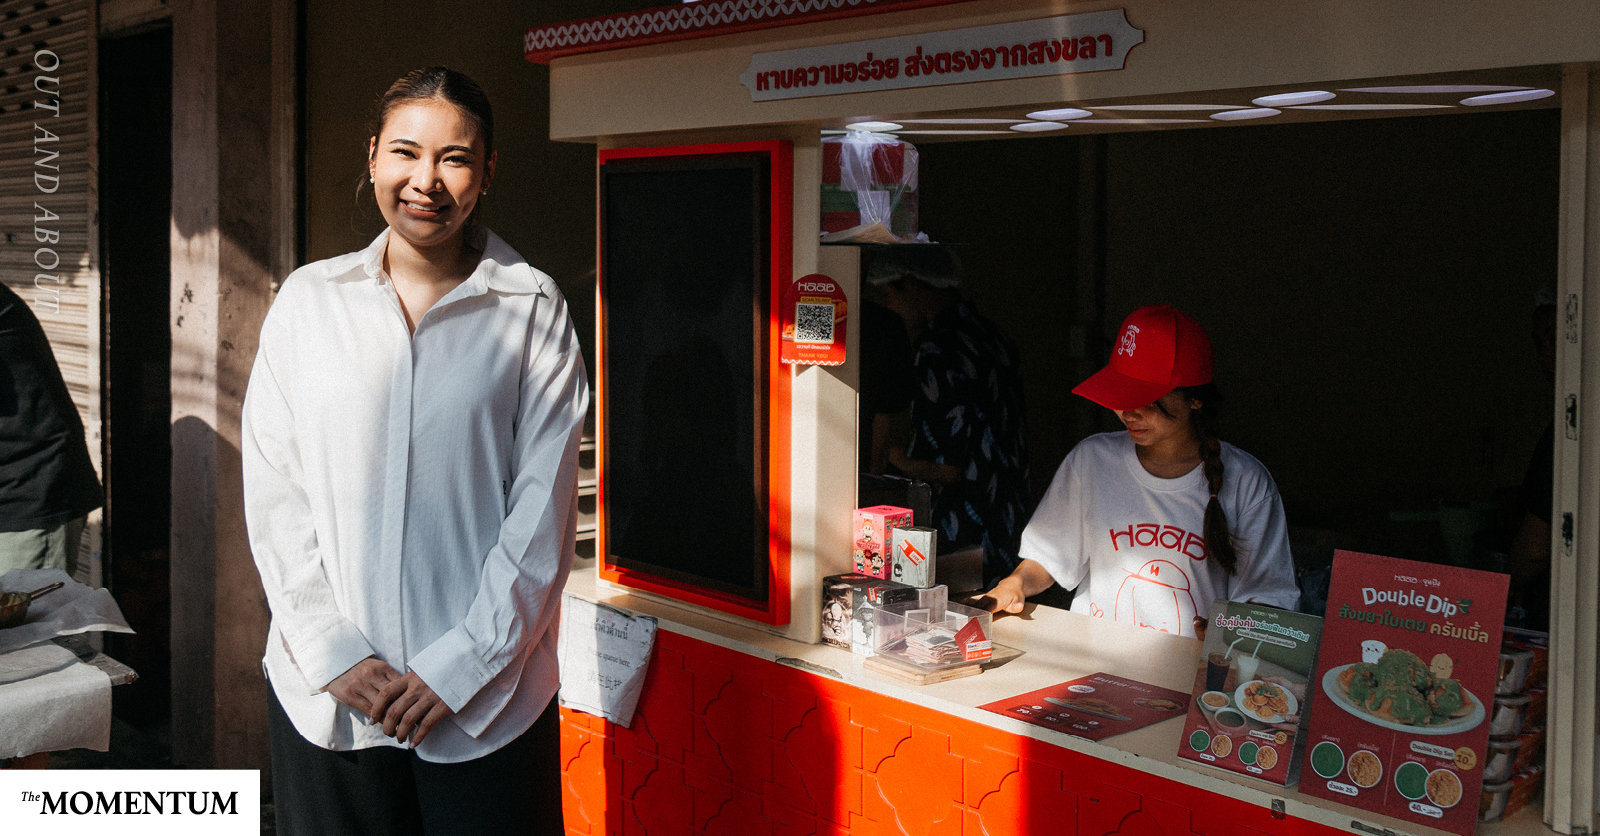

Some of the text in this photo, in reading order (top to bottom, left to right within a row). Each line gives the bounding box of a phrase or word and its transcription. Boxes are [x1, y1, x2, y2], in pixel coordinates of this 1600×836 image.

[756, 33, 1113, 91] หาบความอร่อย ส่งตรงจากสงขลา
[1361, 587, 1458, 618] Double Dip
[1338, 603, 1489, 643] สังขยาใบเตย ครัมเบิ้ล
[1412, 743, 1432, 753] Double
[1432, 748, 1443, 757] Dip
